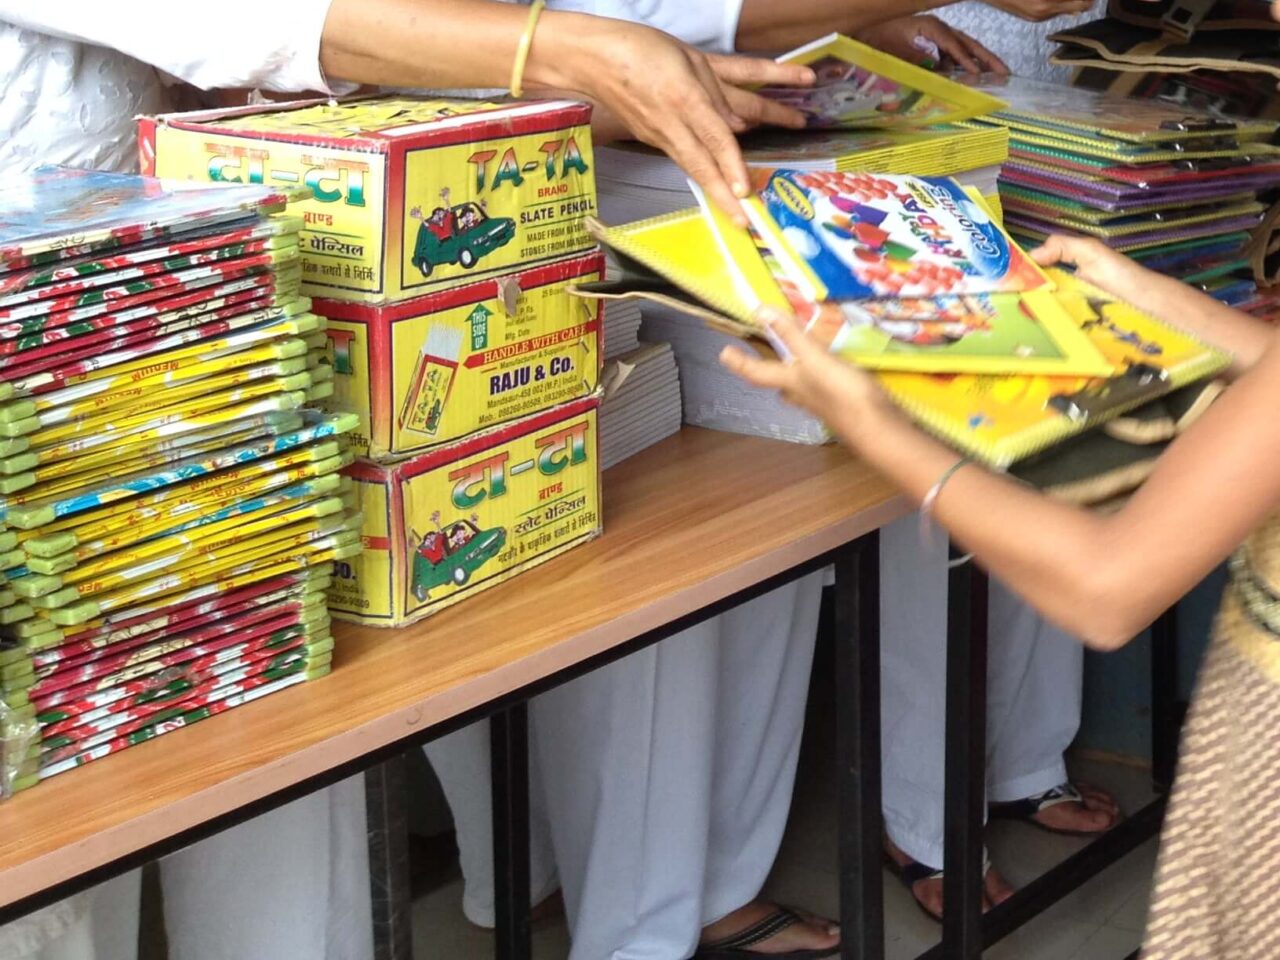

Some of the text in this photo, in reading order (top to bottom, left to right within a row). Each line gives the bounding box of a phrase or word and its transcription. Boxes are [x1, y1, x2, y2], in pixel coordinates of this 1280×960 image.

[467, 135, 589, 195] TA-TA
[537, 184, 568, 198] BRAND
[520, 198, 594, 224] SLATE PENCIL
[472, 311, 486, 325] THIS
[473, 324, 486, 337] SIDE
[474, 337, 485, 349] UP
[484, 341, 529, 364] HANDLE
[531, 334, 559, 351] WITH
[490, 365, 531, 396] RAJU
[534, 364, 546, 381] &
[448, 420, 590, 510] टा-टा
